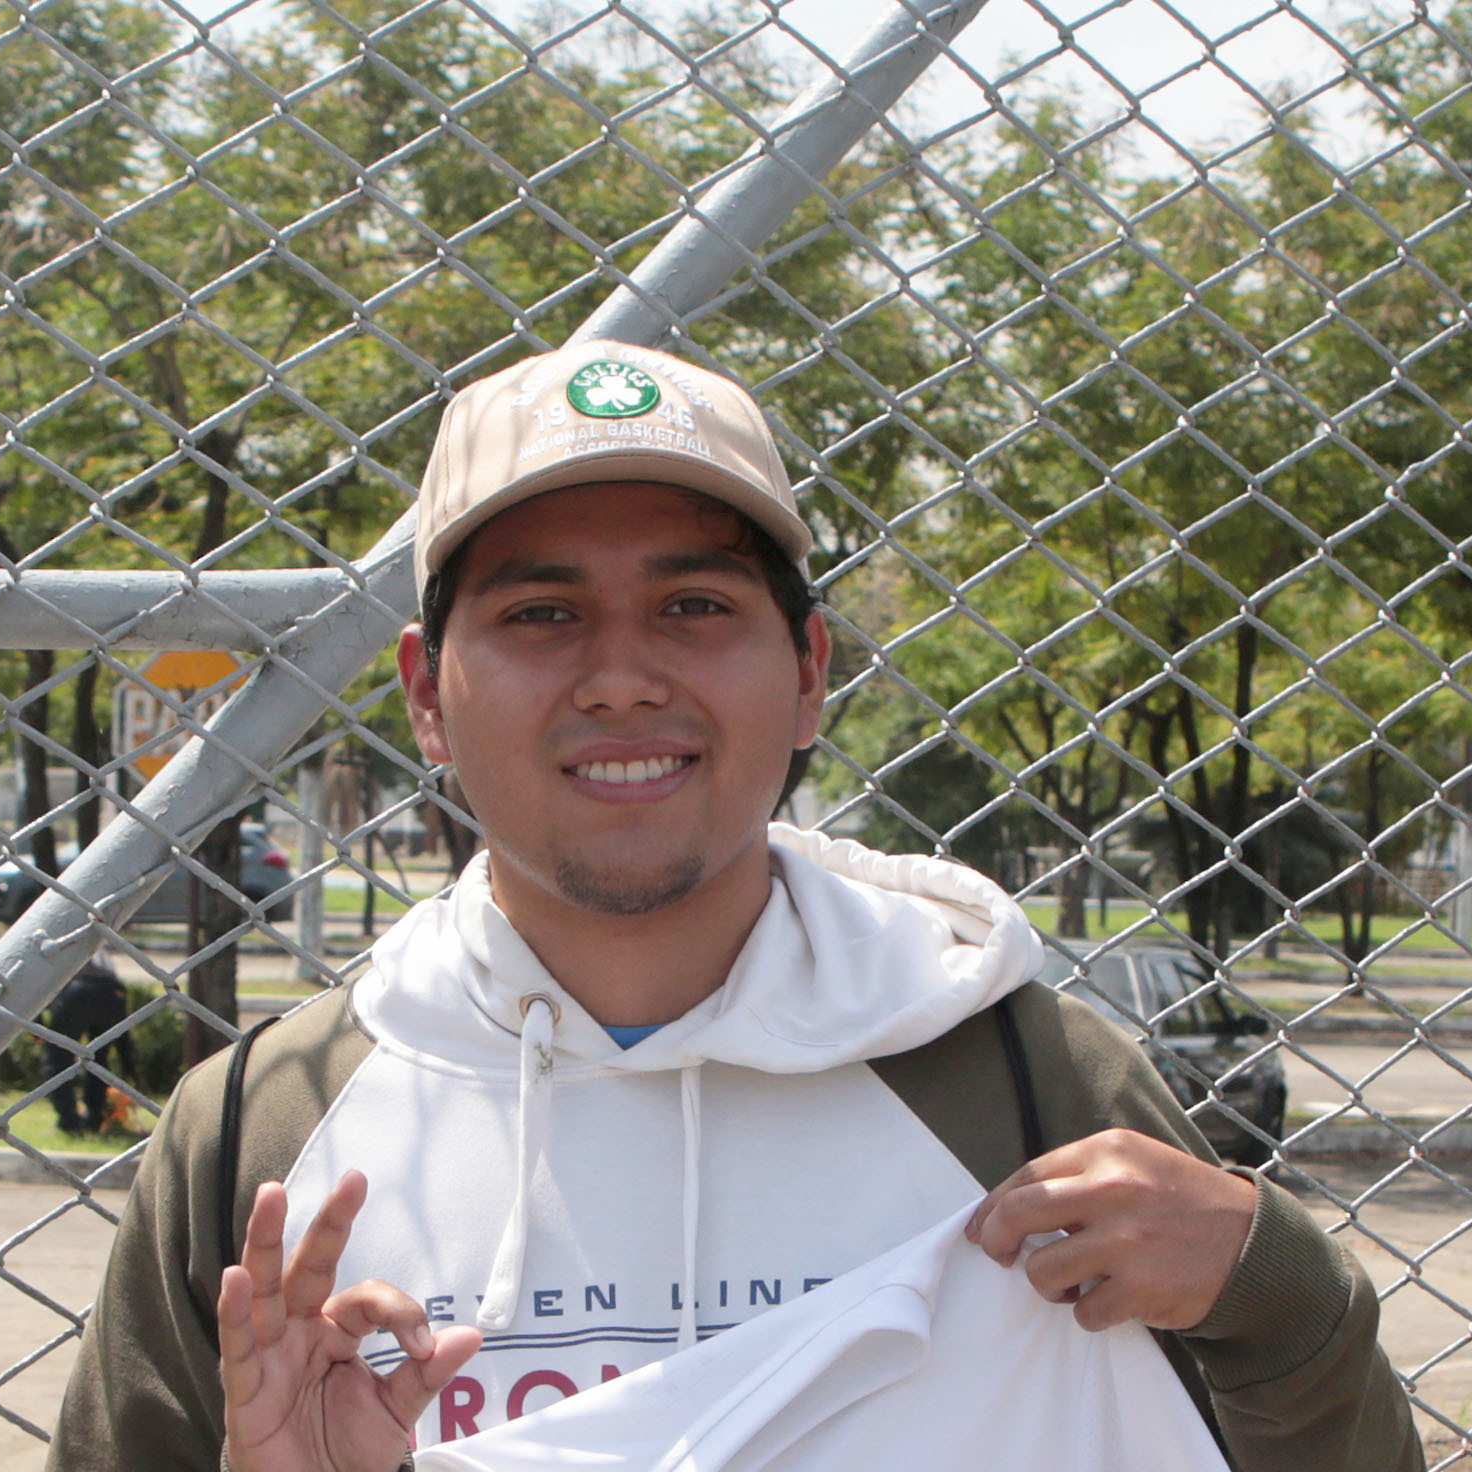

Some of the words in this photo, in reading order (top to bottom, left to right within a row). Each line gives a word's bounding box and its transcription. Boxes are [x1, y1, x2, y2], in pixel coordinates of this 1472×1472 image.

[574, 362, 655, 388] CELTICS
[532, 402, 568, 432] 19
[655, 400, 697, 431] 46
[519, 425, 601, 462] NATIONAL
[607, 423, 713, 458] BASKETBALL
